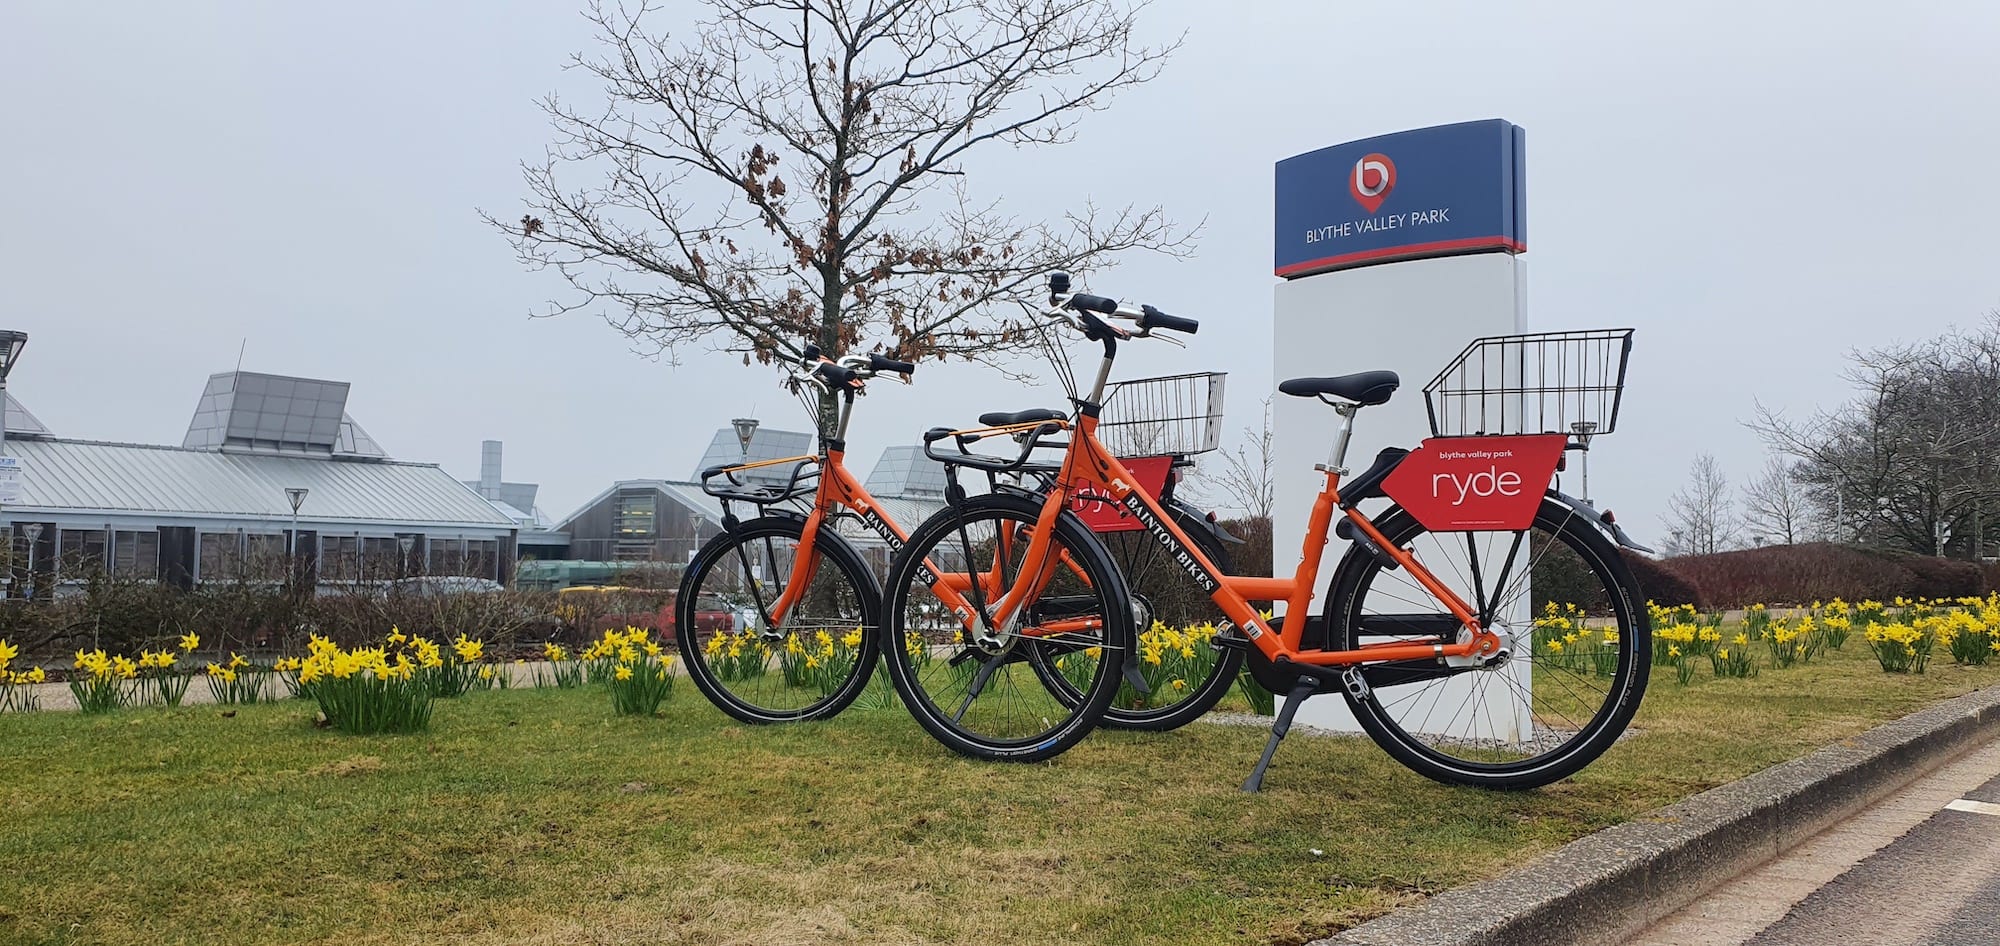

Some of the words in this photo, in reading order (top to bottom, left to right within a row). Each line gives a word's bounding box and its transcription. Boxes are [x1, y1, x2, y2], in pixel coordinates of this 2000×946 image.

[1306, 222, 1351, 244] BLYTHE
[1355, 213, 1407, 233] VALLEY
[1411, 208, 1450, 226] PARK
[1439, 451, 1466, 460] blythe
[1467, 450, 1492, 459] valley
[1493, 449, 1513, 459] park
[1432, 465, 1522, 506] ryde
[1126, 496, 1180, 553] BAINTON
[1176, 550, 1214, 591] BIKES
